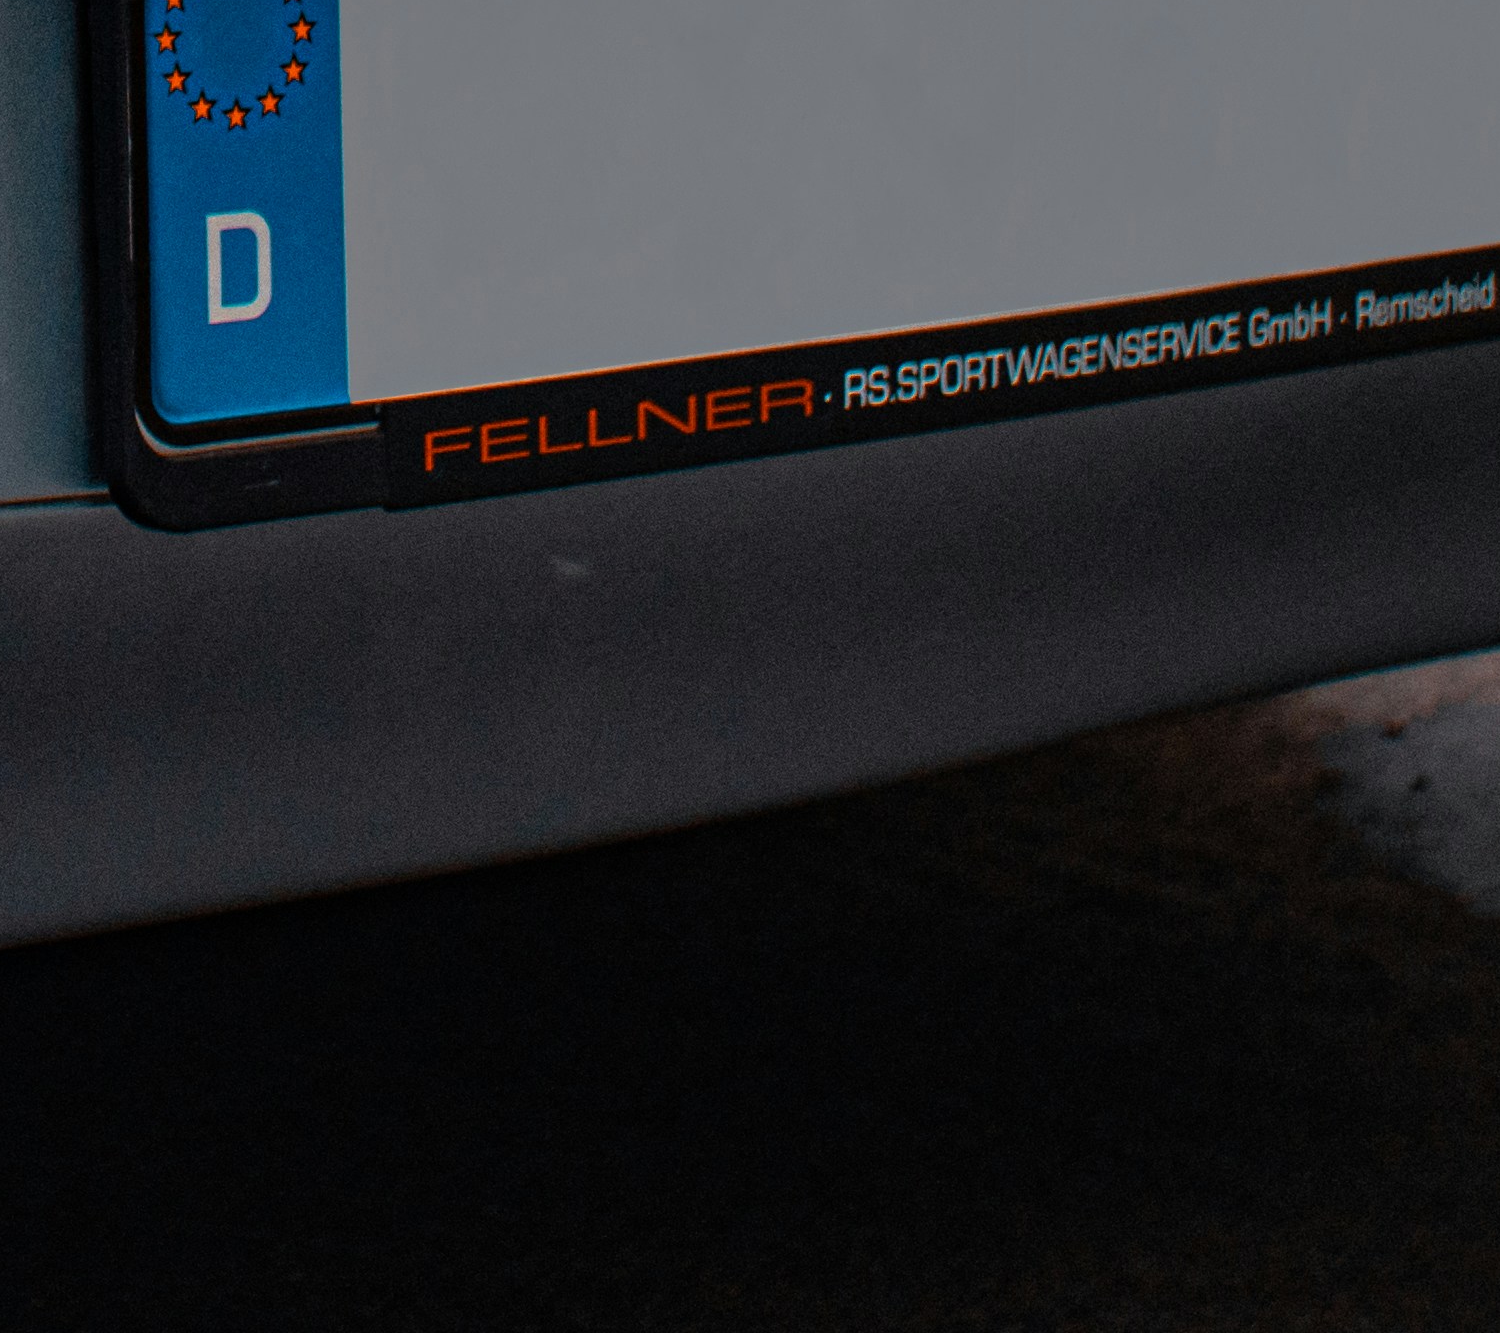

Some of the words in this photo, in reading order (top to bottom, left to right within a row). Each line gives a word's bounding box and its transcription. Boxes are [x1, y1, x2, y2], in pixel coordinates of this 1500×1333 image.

[205, 211, 272, 325] D
[425, 379, 814, 473] FELLNER
[843, 311, 1241, 410] RS.SPORTWAGENSERVICE
[1247, 296, 1332, 351] GmbH
[1355, 270, 1496, 331] Remscheid
